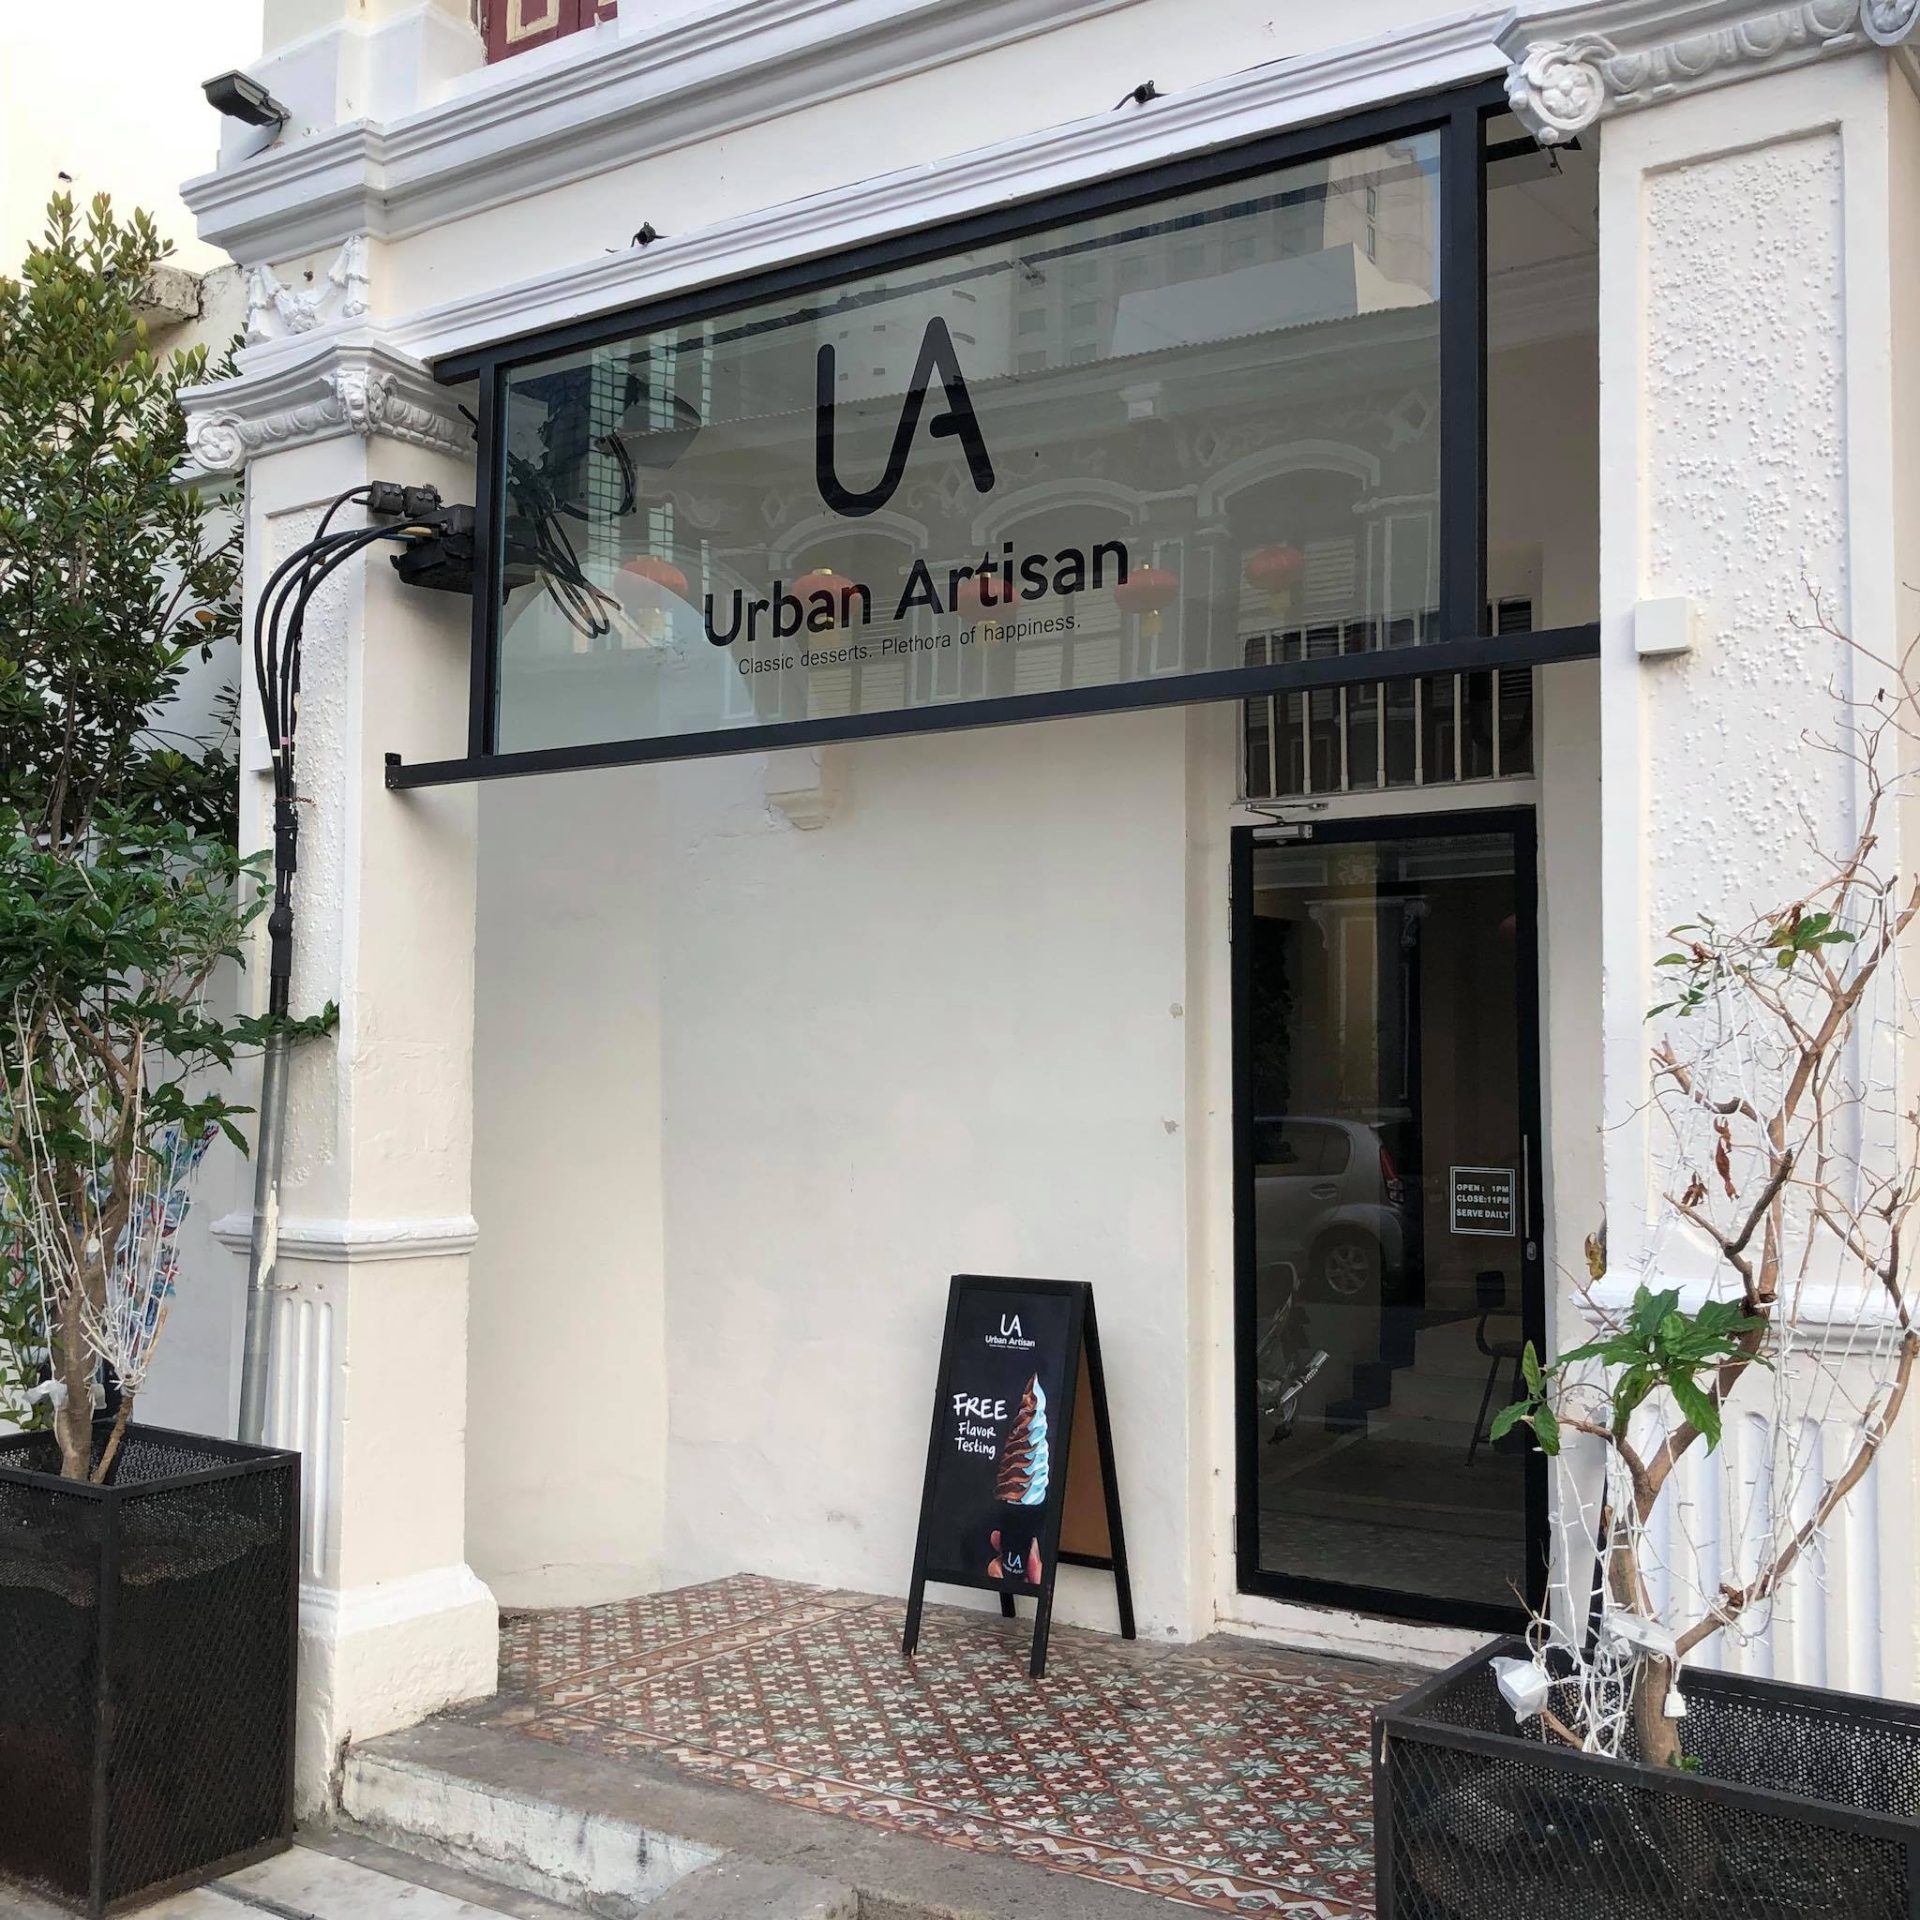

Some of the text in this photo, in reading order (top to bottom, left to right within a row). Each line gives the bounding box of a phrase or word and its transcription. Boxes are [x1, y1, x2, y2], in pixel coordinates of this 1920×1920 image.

[816, 316, 995, 517] UA
[704, 540, 1129, 647] Urban Artisan
[738, 614, 1082, 675] Classic desserts. Plethora of happiness.
[1491, 1185, 1509, 1193] 1PM
[1456, 1208, 1510, 1219] SERVE DAILY
[1000, 1313, 1022, 1337] UA
[985, 1335, 1035, 1347] Urban Artisan
[953, 1393, 1008, 1420] FREE
[954, 1437, 996, 1460] Testing
